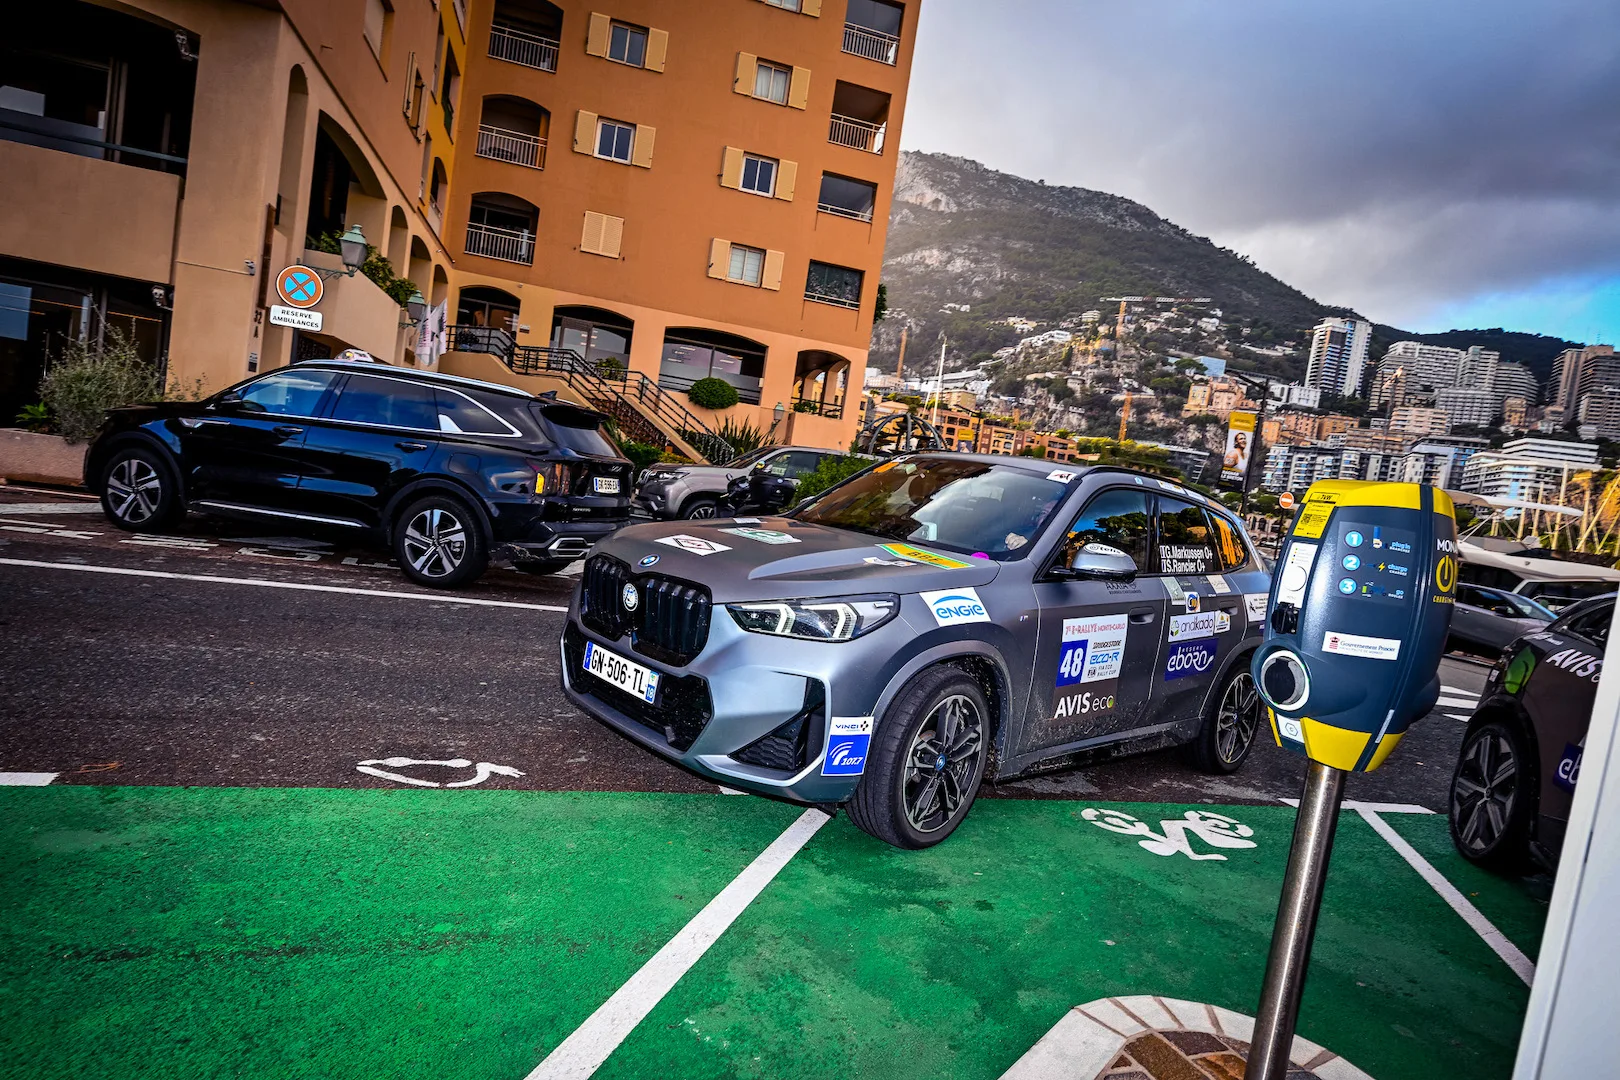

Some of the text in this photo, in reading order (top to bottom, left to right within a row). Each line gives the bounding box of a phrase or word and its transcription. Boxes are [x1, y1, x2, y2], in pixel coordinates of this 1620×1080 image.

[281, 309, 312, 319] RESERVE
[272, 315, 319, 328] AMBULANCES
[1350, 533, 1359, 545] 1
[1166, 546, 1205, 559] G.Markussen
[1166, 560, 1197, 573] S.Rancier
[1345, 556, 1357, 569] 2
[1342, 580, 1354, 592] 3
[1060, 647, 1085, 678] 48
[1054, 692, 1114, 719] AVIS eco
[840, 757, 864, 766] 107.7
